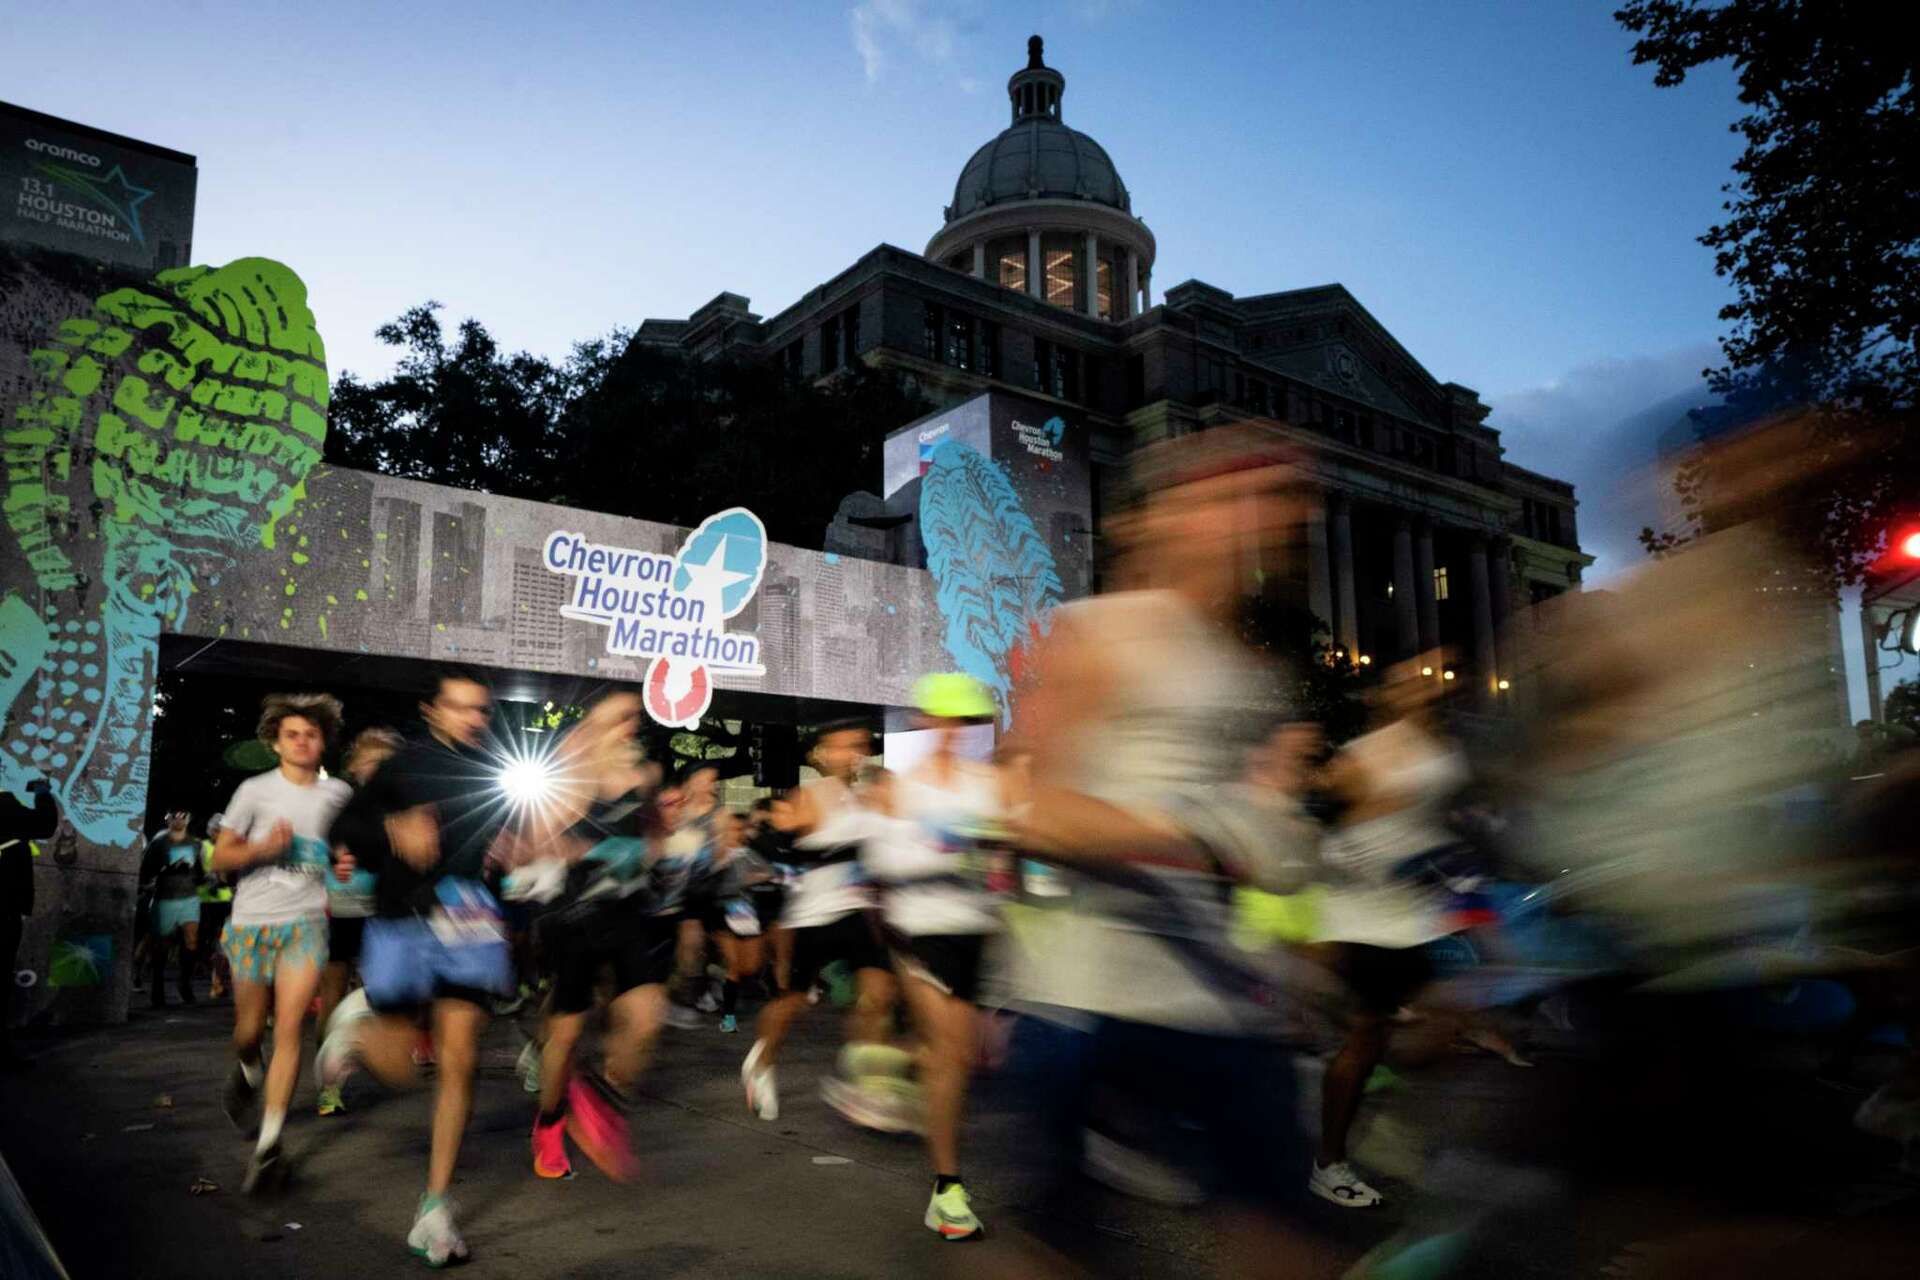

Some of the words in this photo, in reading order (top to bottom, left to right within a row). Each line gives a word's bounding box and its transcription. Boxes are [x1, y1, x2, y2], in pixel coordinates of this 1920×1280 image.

[25, 138, 101, 167] aramco
[21, 176, 54, 197] 13.1
[16, 206, 52, 223] HALF
[56, 217, 130, 243] MARATHON
[19, 192, 115, 227] HOUSTON
[1011, 420, 1041, 436] Chevron
[1019, 431, 1050, 447] Houston
[1027, 443, 1063, 462] Marathon
[548, 536, 672, 583] Chevron
[577, 576, 705, 623] Houston
[612, 617, 755, 664] Marathon
